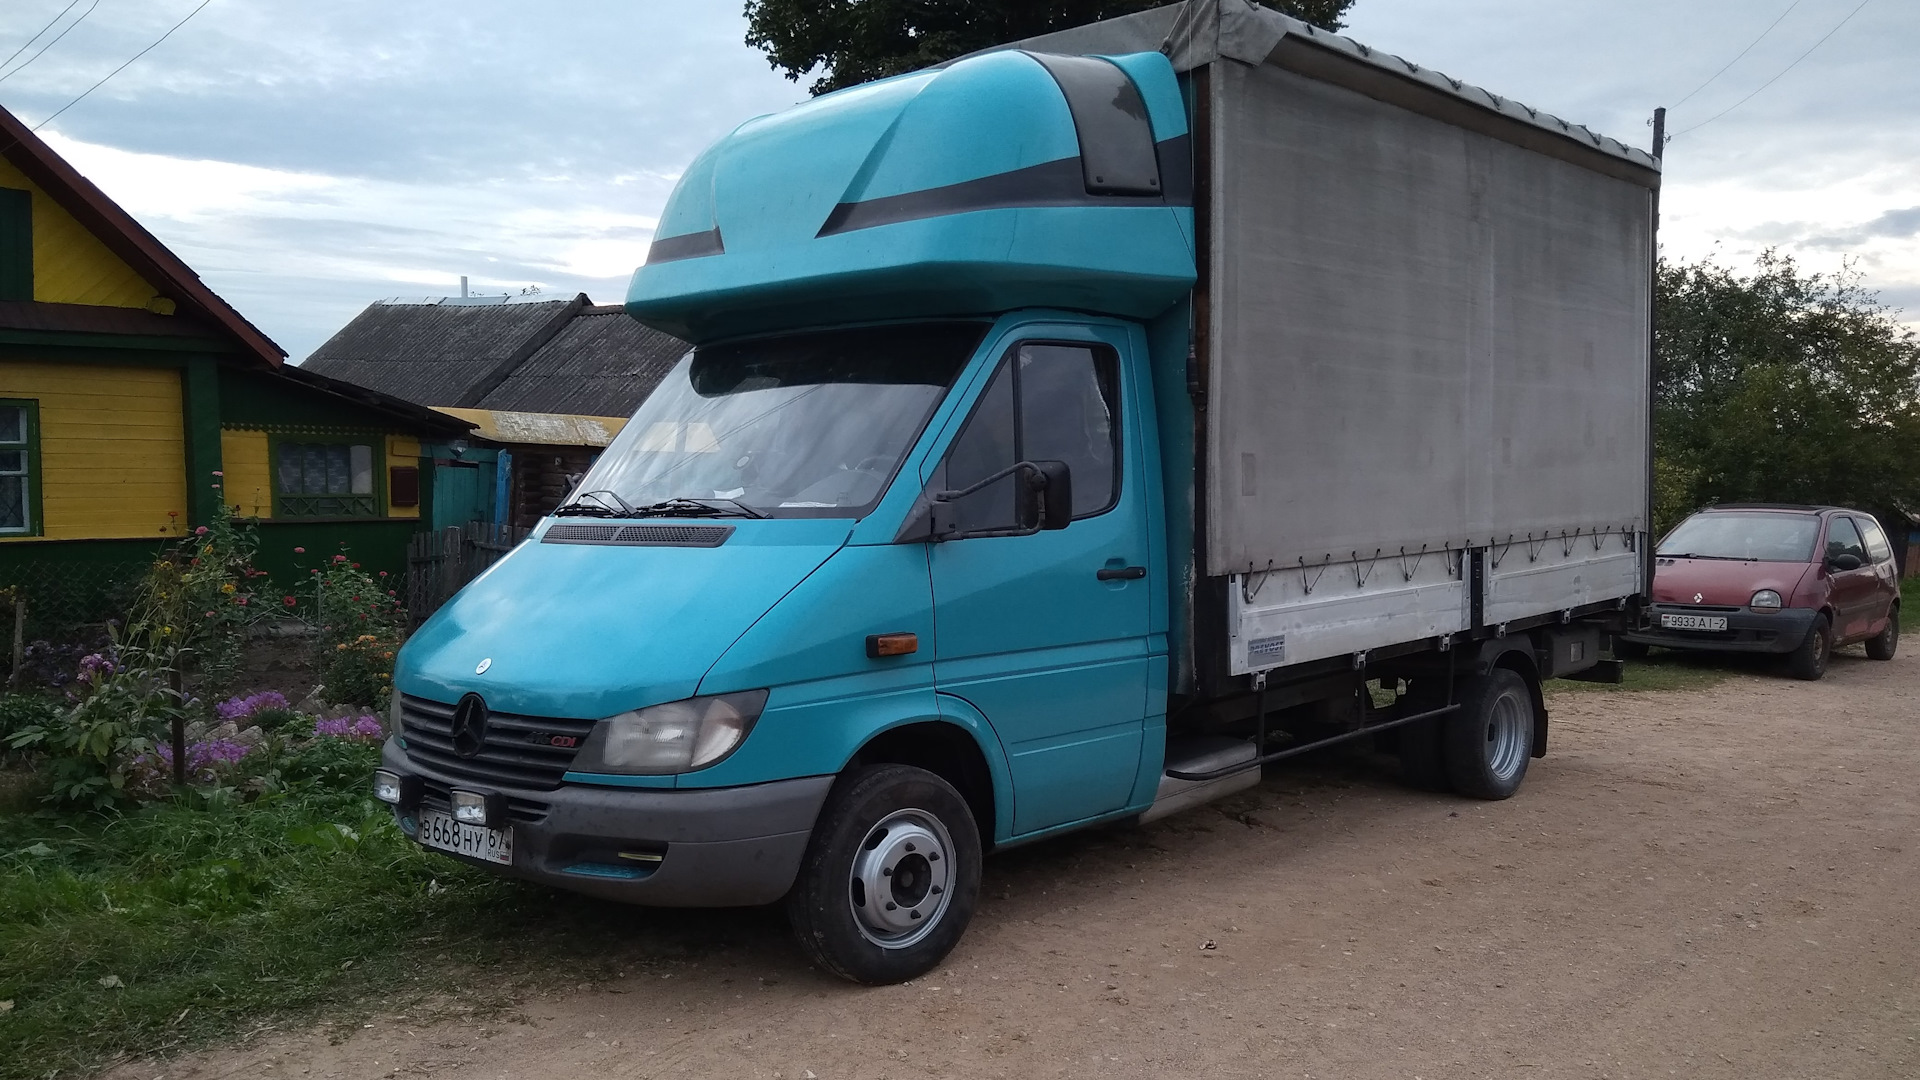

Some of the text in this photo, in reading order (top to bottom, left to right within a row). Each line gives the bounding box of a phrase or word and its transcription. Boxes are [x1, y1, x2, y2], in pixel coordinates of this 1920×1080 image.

[1671, 616, 1696, 628] 9933
[550, 735, 577, 747] CDI
[487, 848, 500, 859] RUS
